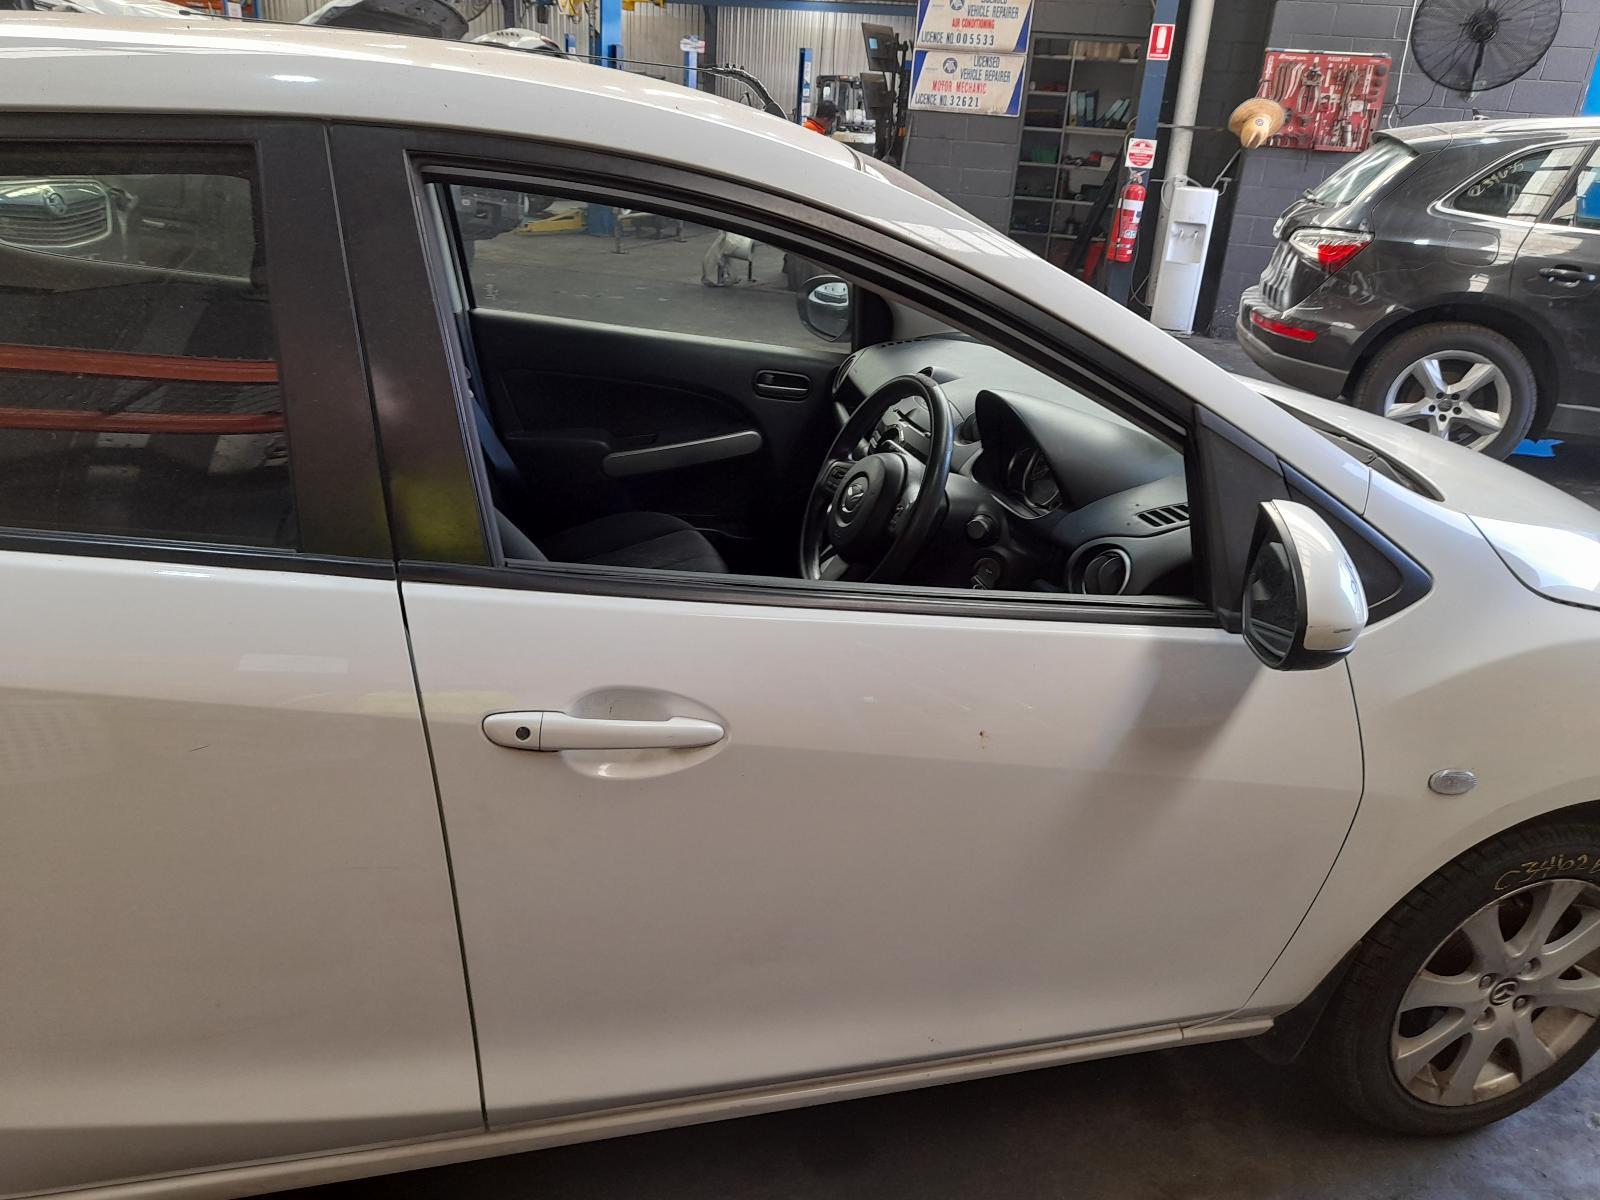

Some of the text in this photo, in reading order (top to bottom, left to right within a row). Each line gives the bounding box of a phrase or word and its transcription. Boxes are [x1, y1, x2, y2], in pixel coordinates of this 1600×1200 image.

[968, 5, 1019, 19] VEHICLE REPAIRER
[952, 18, 995, 29] AIR CONDITIONING
[922, 31, 944, 43] LICENCE
[973, 56, 1000, 69] LICENSED
[960, 68, 1011, 83] VEHICLE REPAIRER
[932, 80, 987, 95] MOTOR MECHANIC
[915, 93, 937, 106] LICENCE
